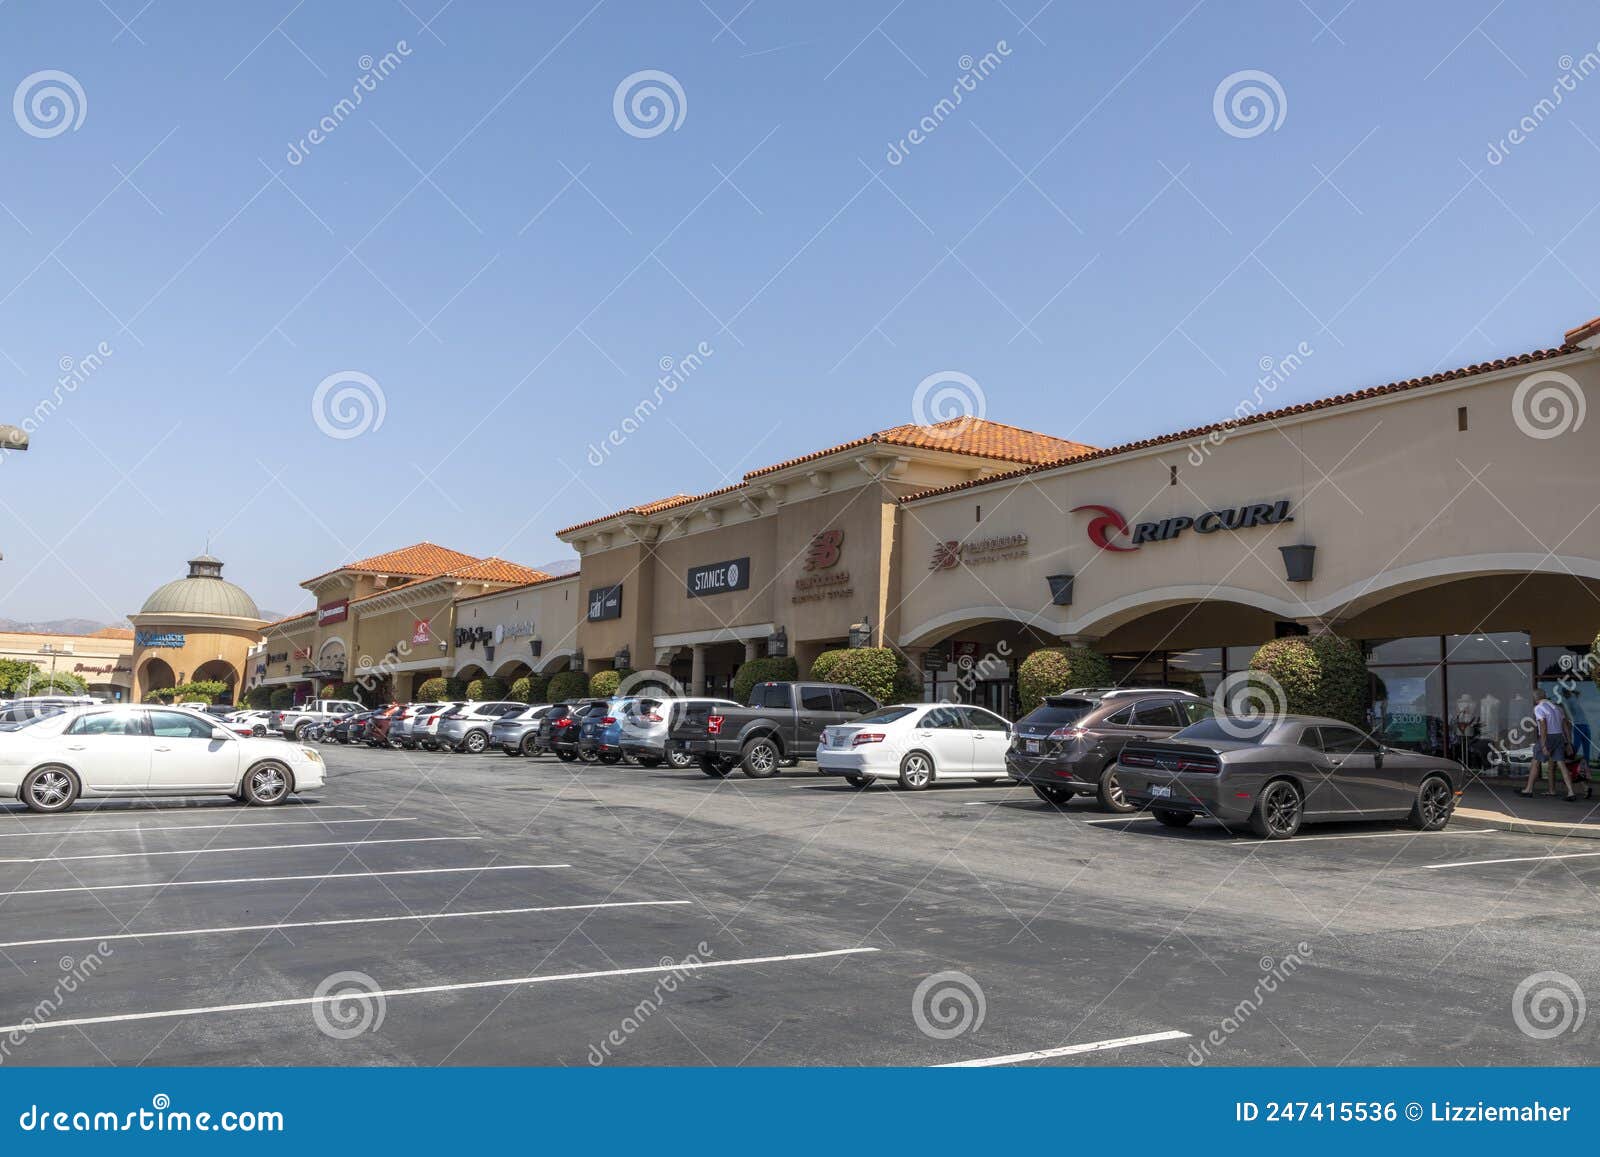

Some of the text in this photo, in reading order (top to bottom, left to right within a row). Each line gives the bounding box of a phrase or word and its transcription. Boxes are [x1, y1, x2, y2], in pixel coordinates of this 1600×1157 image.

[1132, 500, 1295, 544] RIP CURL
[695, 568, 726, 591] STANCE
